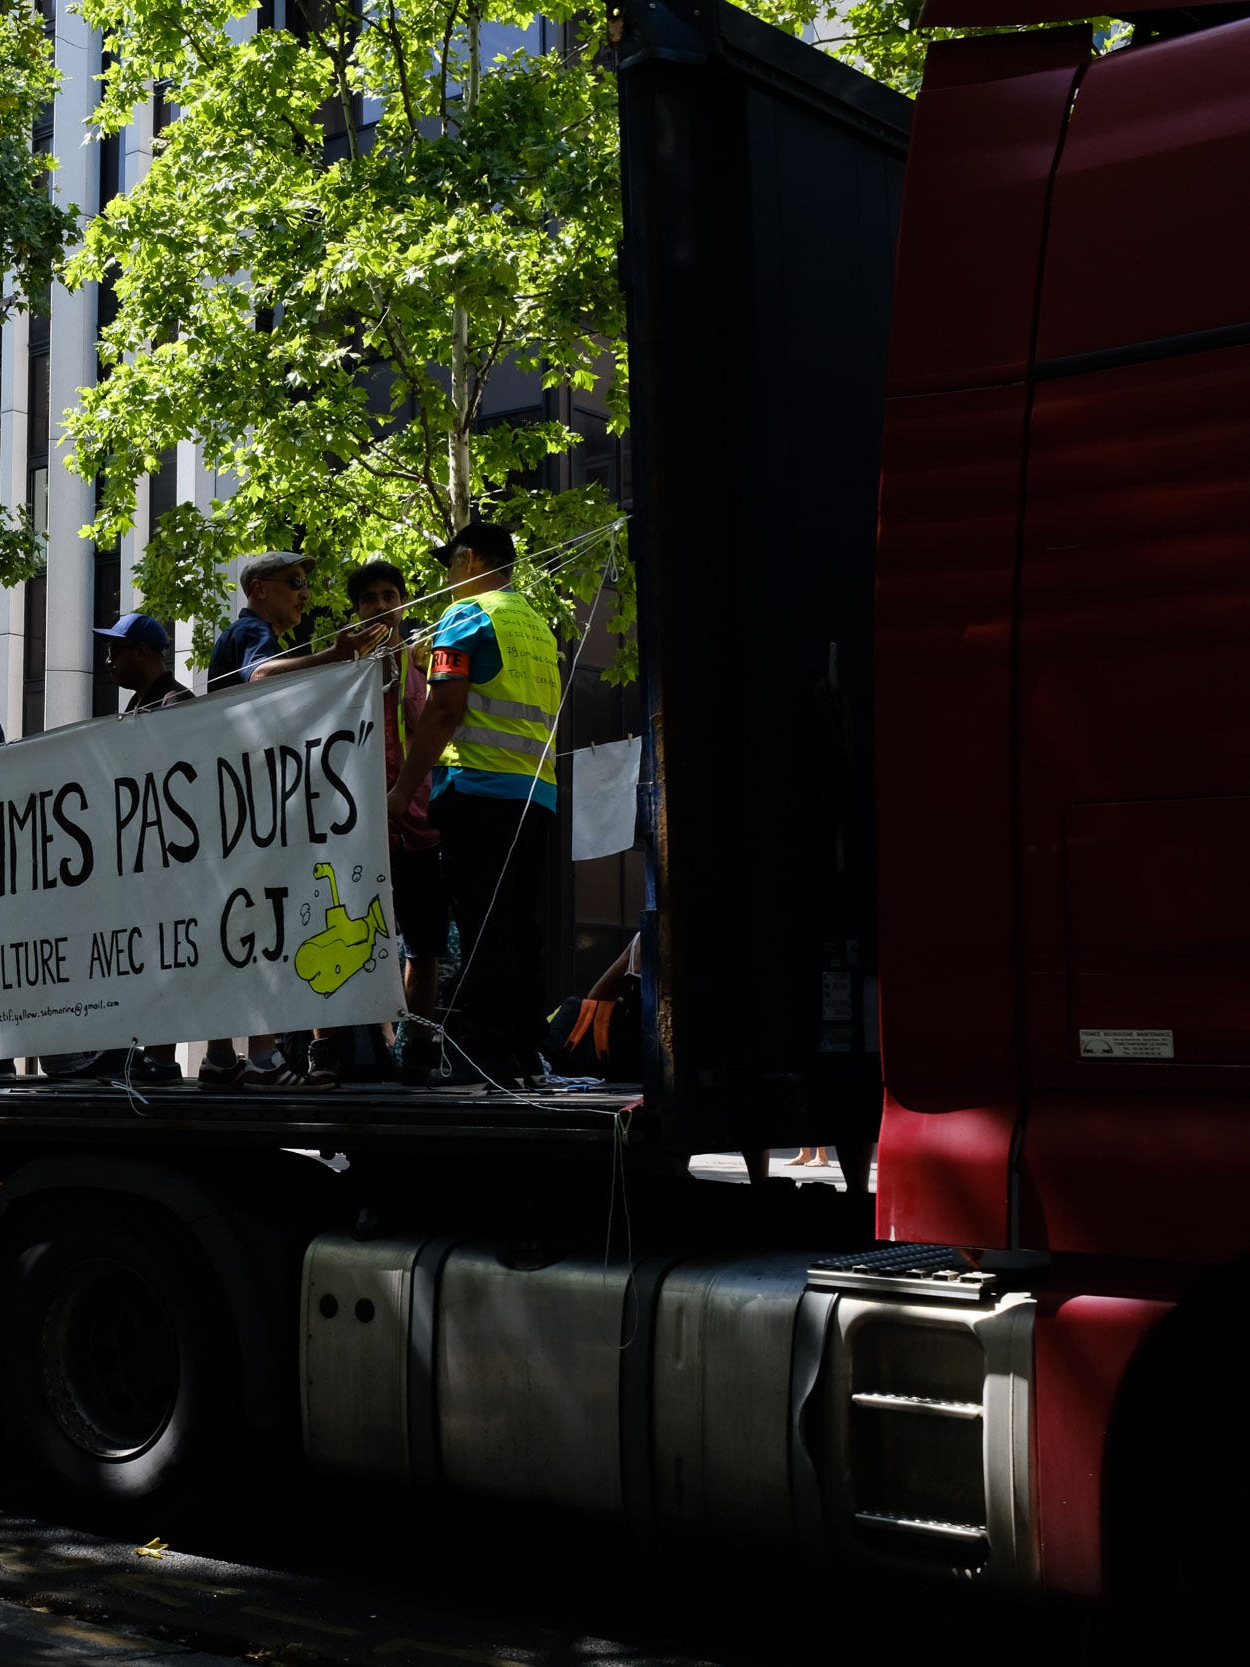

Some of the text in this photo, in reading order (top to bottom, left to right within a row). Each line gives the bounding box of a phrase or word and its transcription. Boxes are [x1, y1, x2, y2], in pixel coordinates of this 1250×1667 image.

[114, 760, 200, 877] PAS
[89, 927, 145, 979] AVEC
[159, 917, 199, 970] LES
[220, 887, 289, 968] G.J.
